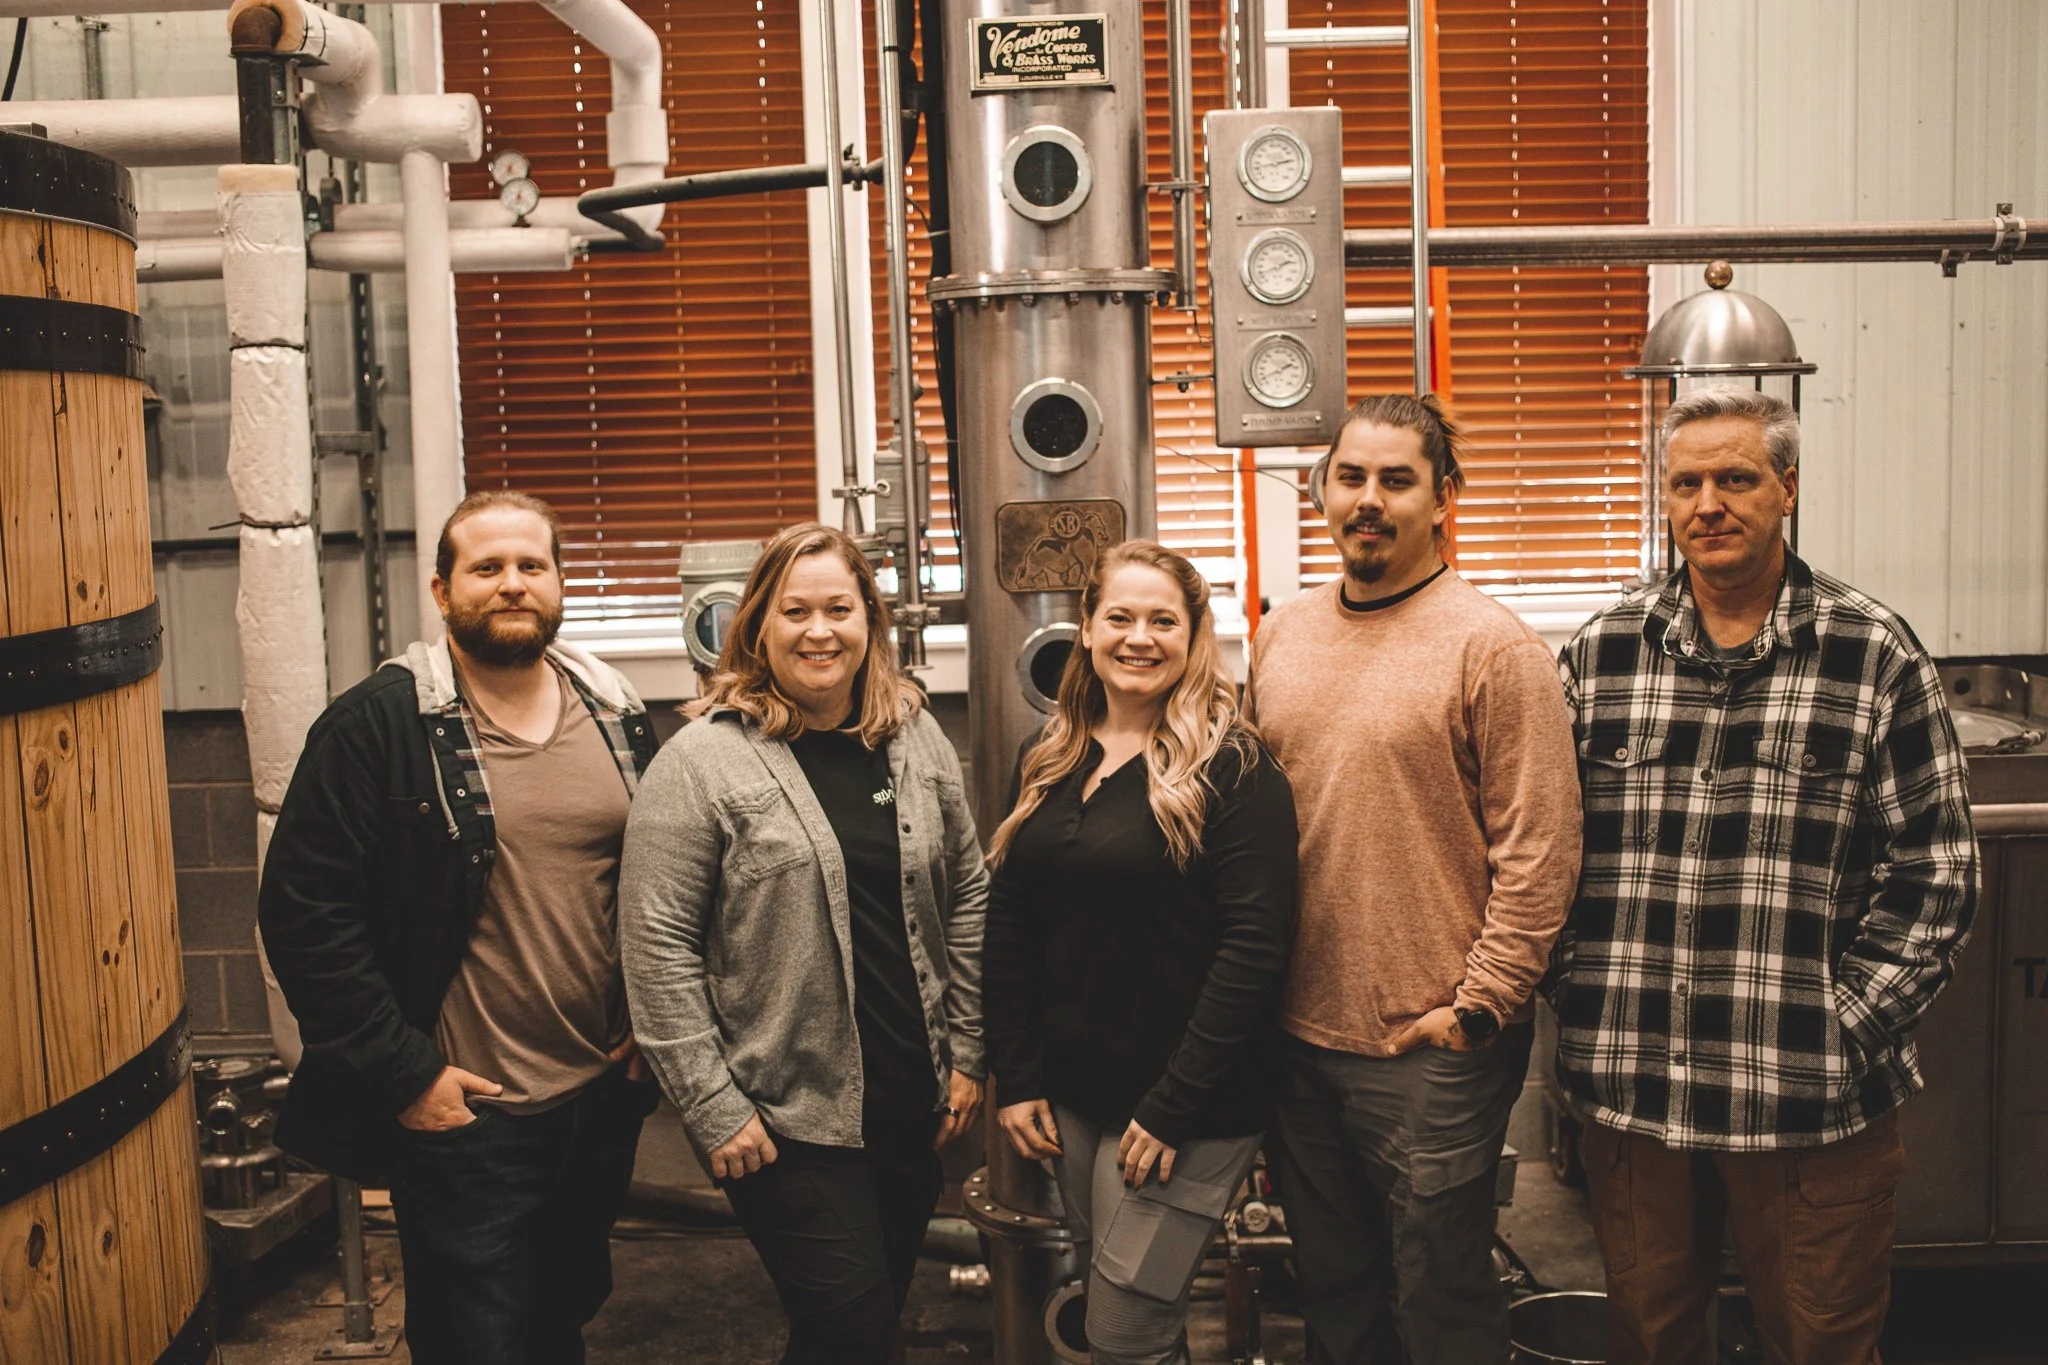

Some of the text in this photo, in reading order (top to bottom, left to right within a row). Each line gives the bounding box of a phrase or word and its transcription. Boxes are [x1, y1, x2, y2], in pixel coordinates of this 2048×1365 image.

[986, 25, 1081, 69] Vendome
[1044, 43, 1087, 54] COPPER
[1001, 53, 1096, 68] & BRASS WORKS
[1012, 65, 1072, 73] INCORPORATED
[2013, 957, 2048, 999] T
